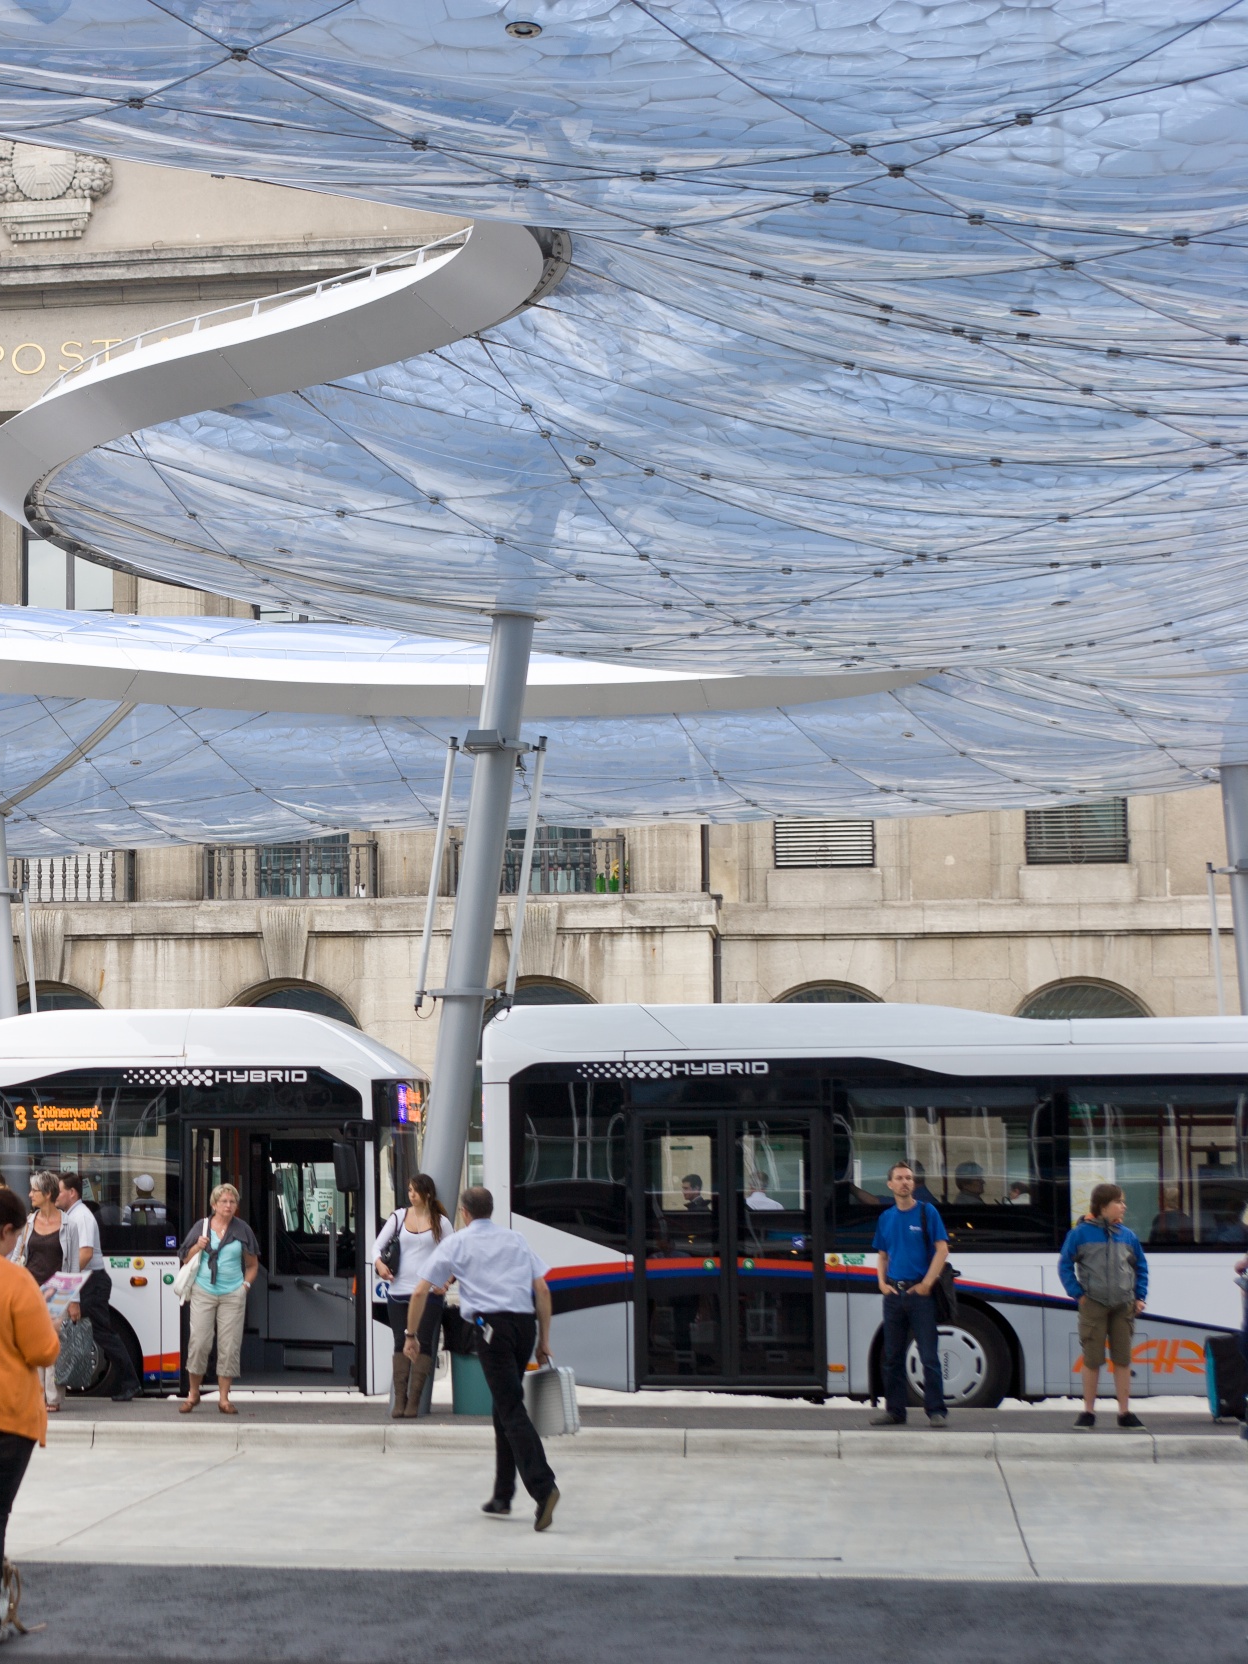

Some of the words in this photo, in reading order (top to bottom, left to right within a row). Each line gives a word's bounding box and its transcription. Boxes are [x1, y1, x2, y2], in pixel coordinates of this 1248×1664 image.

[672, 1061, 769, 1075] HYBRID
[215, 1070, 308, 1083] HYBRID
[15, 1106, 27, 1131] 3
[33, 1105, 103, 1119] Schönenwerd-
[37, 1119, 98, 1131] Gretzenbach
